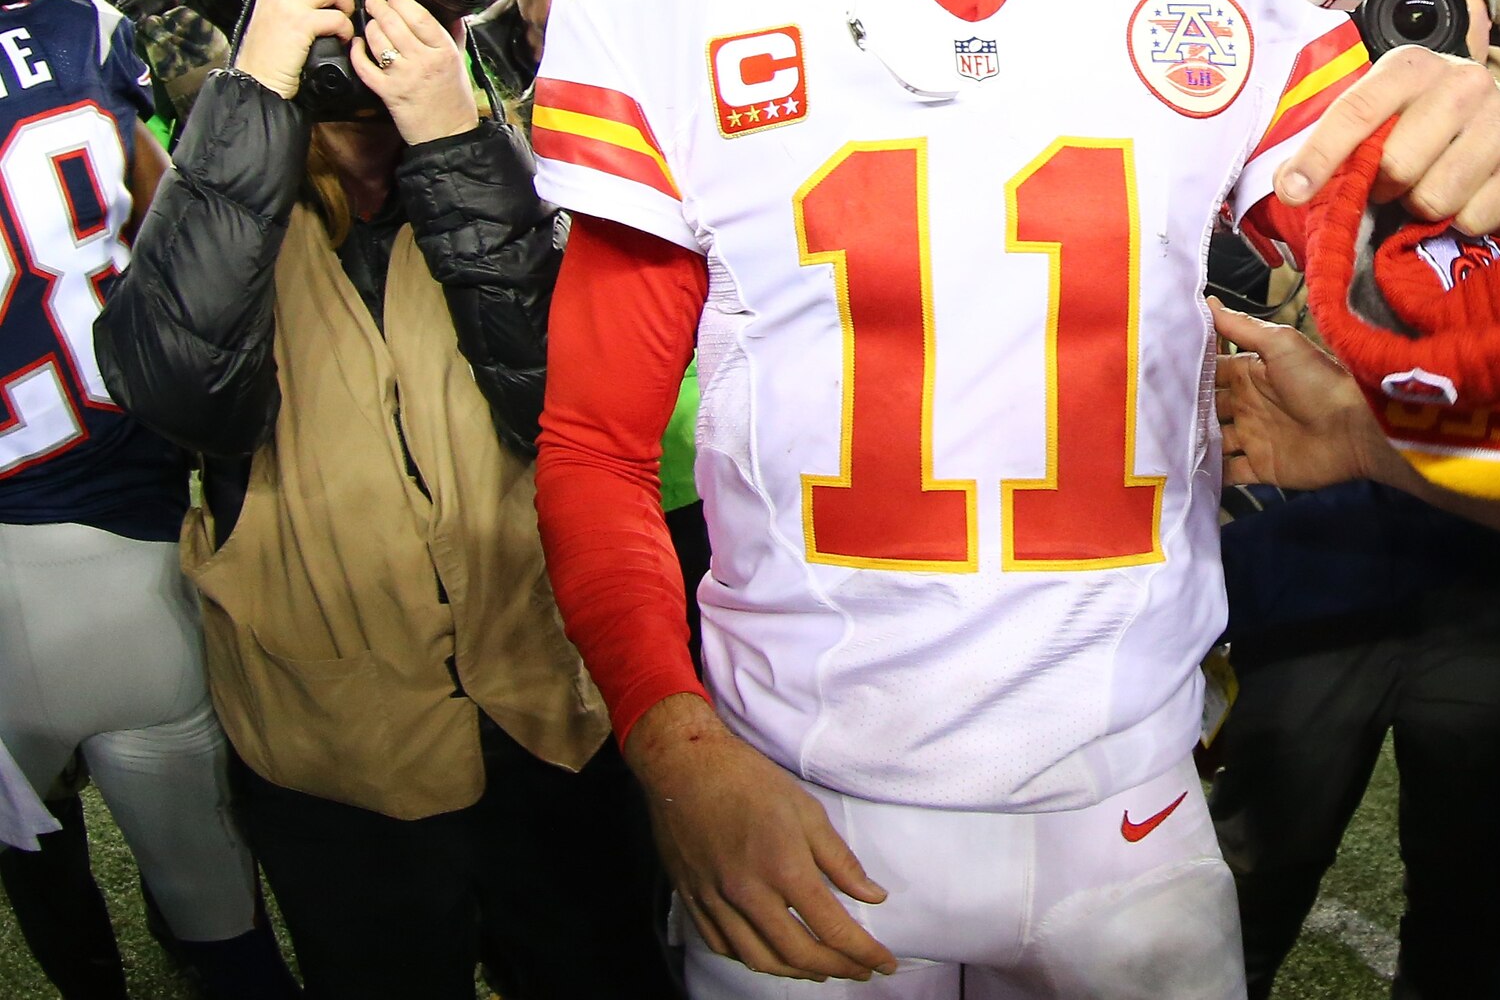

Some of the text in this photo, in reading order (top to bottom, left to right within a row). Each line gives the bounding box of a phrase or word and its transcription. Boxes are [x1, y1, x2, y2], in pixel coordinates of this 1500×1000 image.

[0, 26, 53, 100] E
[960, 55, 996, 76] NFL
[1151, 4, 1236, 66] A
[715, 32, 799, 107] C
[1186, 70, 1212, 87] LH
[792, 136, 1168, 573] 11
